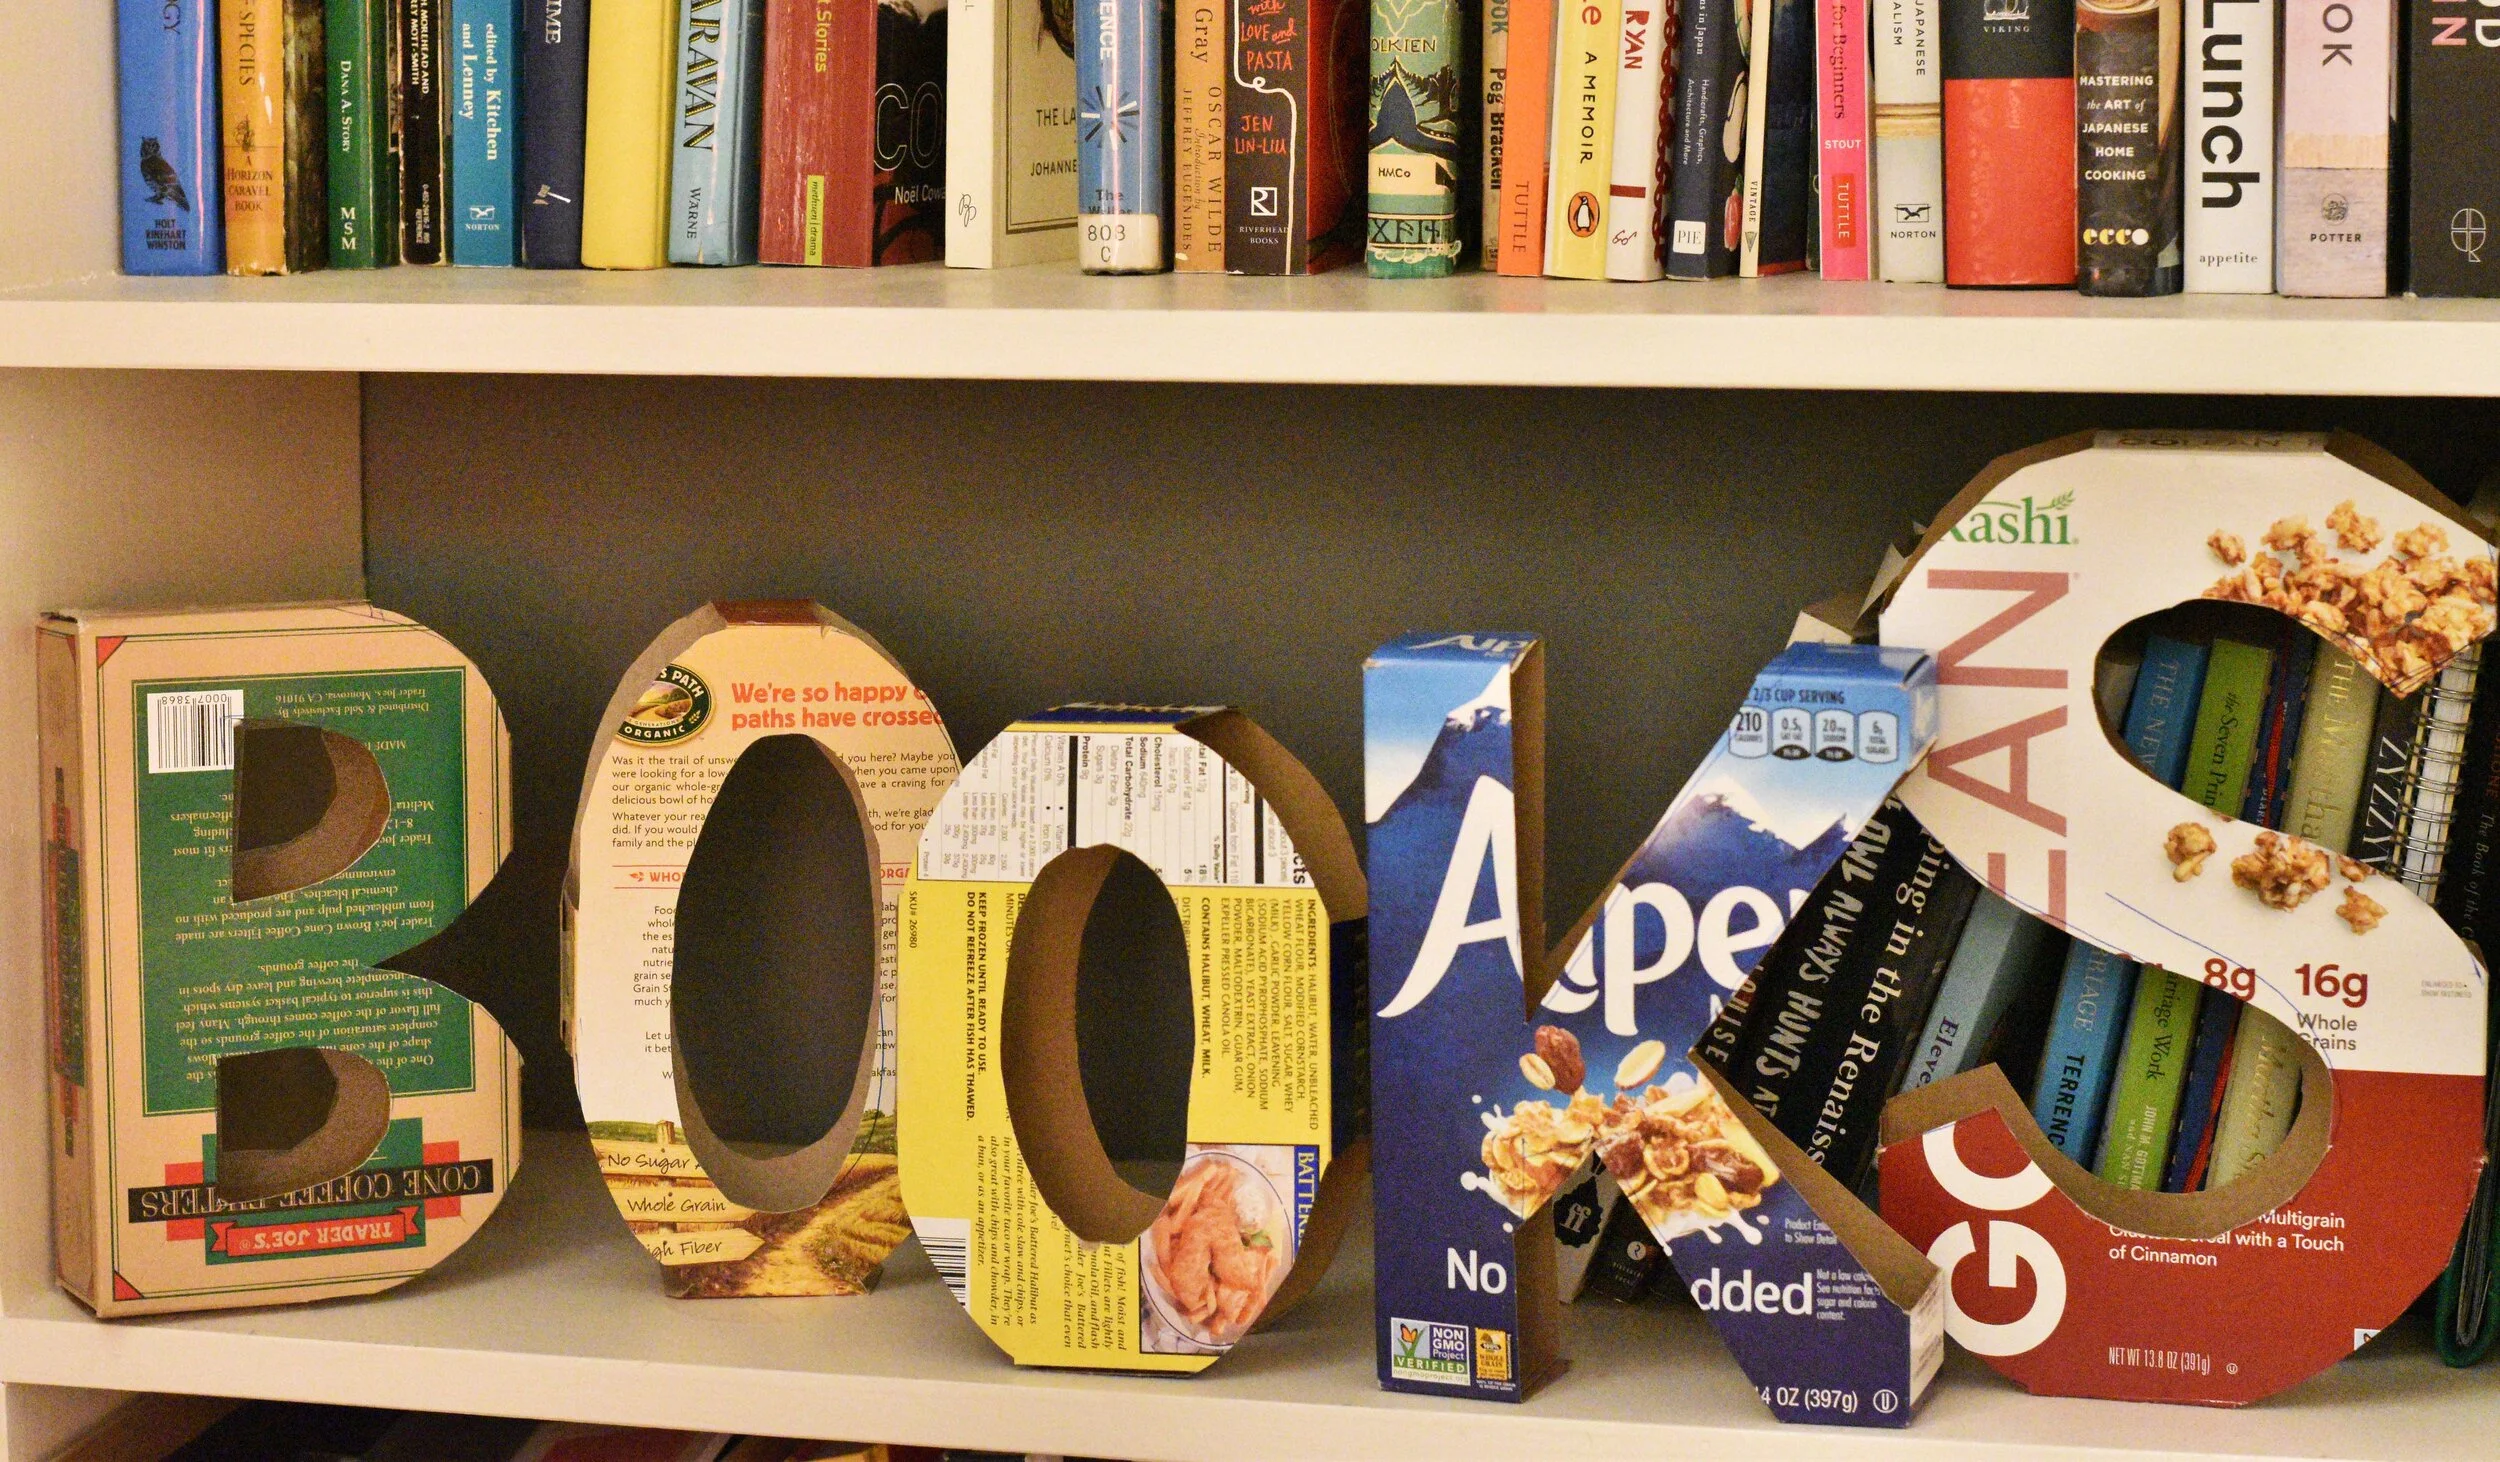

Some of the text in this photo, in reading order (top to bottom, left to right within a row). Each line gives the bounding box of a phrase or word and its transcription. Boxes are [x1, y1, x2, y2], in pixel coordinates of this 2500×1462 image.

[1191, 8, 1213, 64] Gray
[1241, 18, 1297, 42] LOVE and
[1624, 10, 1650, 70] RYAN
[1694, 11, 1705, 55] in Japan
[1915, 0, 1926, 75] JAPANESE
[239, 12, 255, 85] SPECIES
[816, 12, 832, 73] Stories
[459, 23, 478, 120] and Lenney
[1247, 51, 1293, 71] PASTA
[1830, 5, 1848, 119] for Beginners
[484, 23, 501, 160] edited by Kitchen
[1487, 68, 1507, 104] Peg
[2080, 75, 2153, 86] MASTERING
[1580, 52, 1598, 164] A MEMOIR
[1685, 78, 1694, 124] Architecture
[2087, 100, 2146, 113] the ART of
[2201, 0, 2260, 208] Lunch
[1037, 109, 1058, 127] THE
[1241, 115, 1273, 132] JEN
[1696, 79, 1710, 165] Handicrafts, Graphics,
[2082, 123, 2149, 134] JAPANESE
[1235, 137, 1287, 154] LIN-LIU
[1683, 143, 1691, 165] More
[1825, 140, 1862, 150] STOUT
[2095, 147, 2134, 158] HOME
[228, 170, 272, 181] HORIZON
[1031, 160, 1077, 177] JOHANNE
[1183, 89, 1192, 250] JEFFREY EUGENIDES
[1208, 86, 1222, 252] OSCAR WILDE
[2084, 170, 2146, 181] COOKING
[228, 186, 269, 196] CARAVEL
[895, 186, 918, 204] Noël
[1096, 189, 1123, 201] The
[1749, 181, 1758, 223] VINTAGE
[235, 200, 263, 211] BOOK
[687, 188, 701, 239] WARNE
[1513, 181, 1530, 253] TUTTLE
[1838, 183, 1849, 238] TUTTLE
[146, 229, 186, 239] RINEHART
[155, 219, 175, 228] HOLT
[1891, 231, 1937, 239] NORTON
[147, 240, 186, 250] WINSTON
[1678, 230, 1702, 244] PIE
[2083, 229, 2149, 245] ecco
[2310, 233, 2362, 243] POTTER
[1101, 247, 1111, 263] C
[2199, 252, 2259, 266] appetite
[672, 669, 704, 698] PATH
[732, 681, 907, 704] We're so happy
[2330, 660, 2356, 703] THE
[160, 693, 228, 705] 0007 3868
[1775, 688, 1796, 701] CUP
[1799, 689, 1845, 704] SERVING
[732, 707, 856, 731] paths have
[624, 725, 685, 738] ORGANIC
[612, 755, 704, 765] Was it the trail of
[1083, 736, 1091, 768] Protein
[1153, 737, 1163, 788] Cholesterol
[1122, 737, 1134, 821] Total Carbohydrate
[612, 795, 657, 804] delicious
[909, 891, 918, 949] SKU# 26980
[1308, 899, 1317, 970] INGREDIENTS:
[1756, 818, 1892, 1079] OWL ALWAYS HUNTS
[1860, 919, 1925, 1024] in the
[2202, 958, 2368, 1008] 8g 16g
[978, 892, 987, 1075] KEEP FROZEN UNTIL READY TO USE.
[1201, 897, 1211, 1079] CONTAINS HALIBUT, WHEAT, MILK.
[967, 892, 975, 1120] DO NOT REFREEZE AFTER FISH HAS THAWED.
[2296, 1012, 2358, 1031] Whole
[2146, 1035, 2173, 1080] Work
[608, 1153, 690, 1176] No Sugar
[404, 1165, 481, 1197] CONE
[627, 1198, 727, 1214] Whole Grain
[254, 1221, 393, 1250] TRADER JOE'S
[976, 1211, 985, 1266] appetizer.
[2236, 1231, 2272, 1248] with
[2277, 1236, 2287, 1248] a
[2292, 1233, 2344, 1252] Touch
[681, 1240, 722, 1256] Fiber
[2109, 1245, 2217, 1267] of Cinnamon
[1447, 1247, 1508, 1295] No
[1433, 1327, 1464, 1339] NON
[1433, 1340, 1464, 1351] GMO
[1433, 1349, 1464, 1360] Project
[1396, 1357, 1465, 1373] VERIFIED
[2109, 1347, 2211, 1375] NET WT 13.8 OZ (391g)
[1776, 1387, 1858, 1413] OZ (397g)
